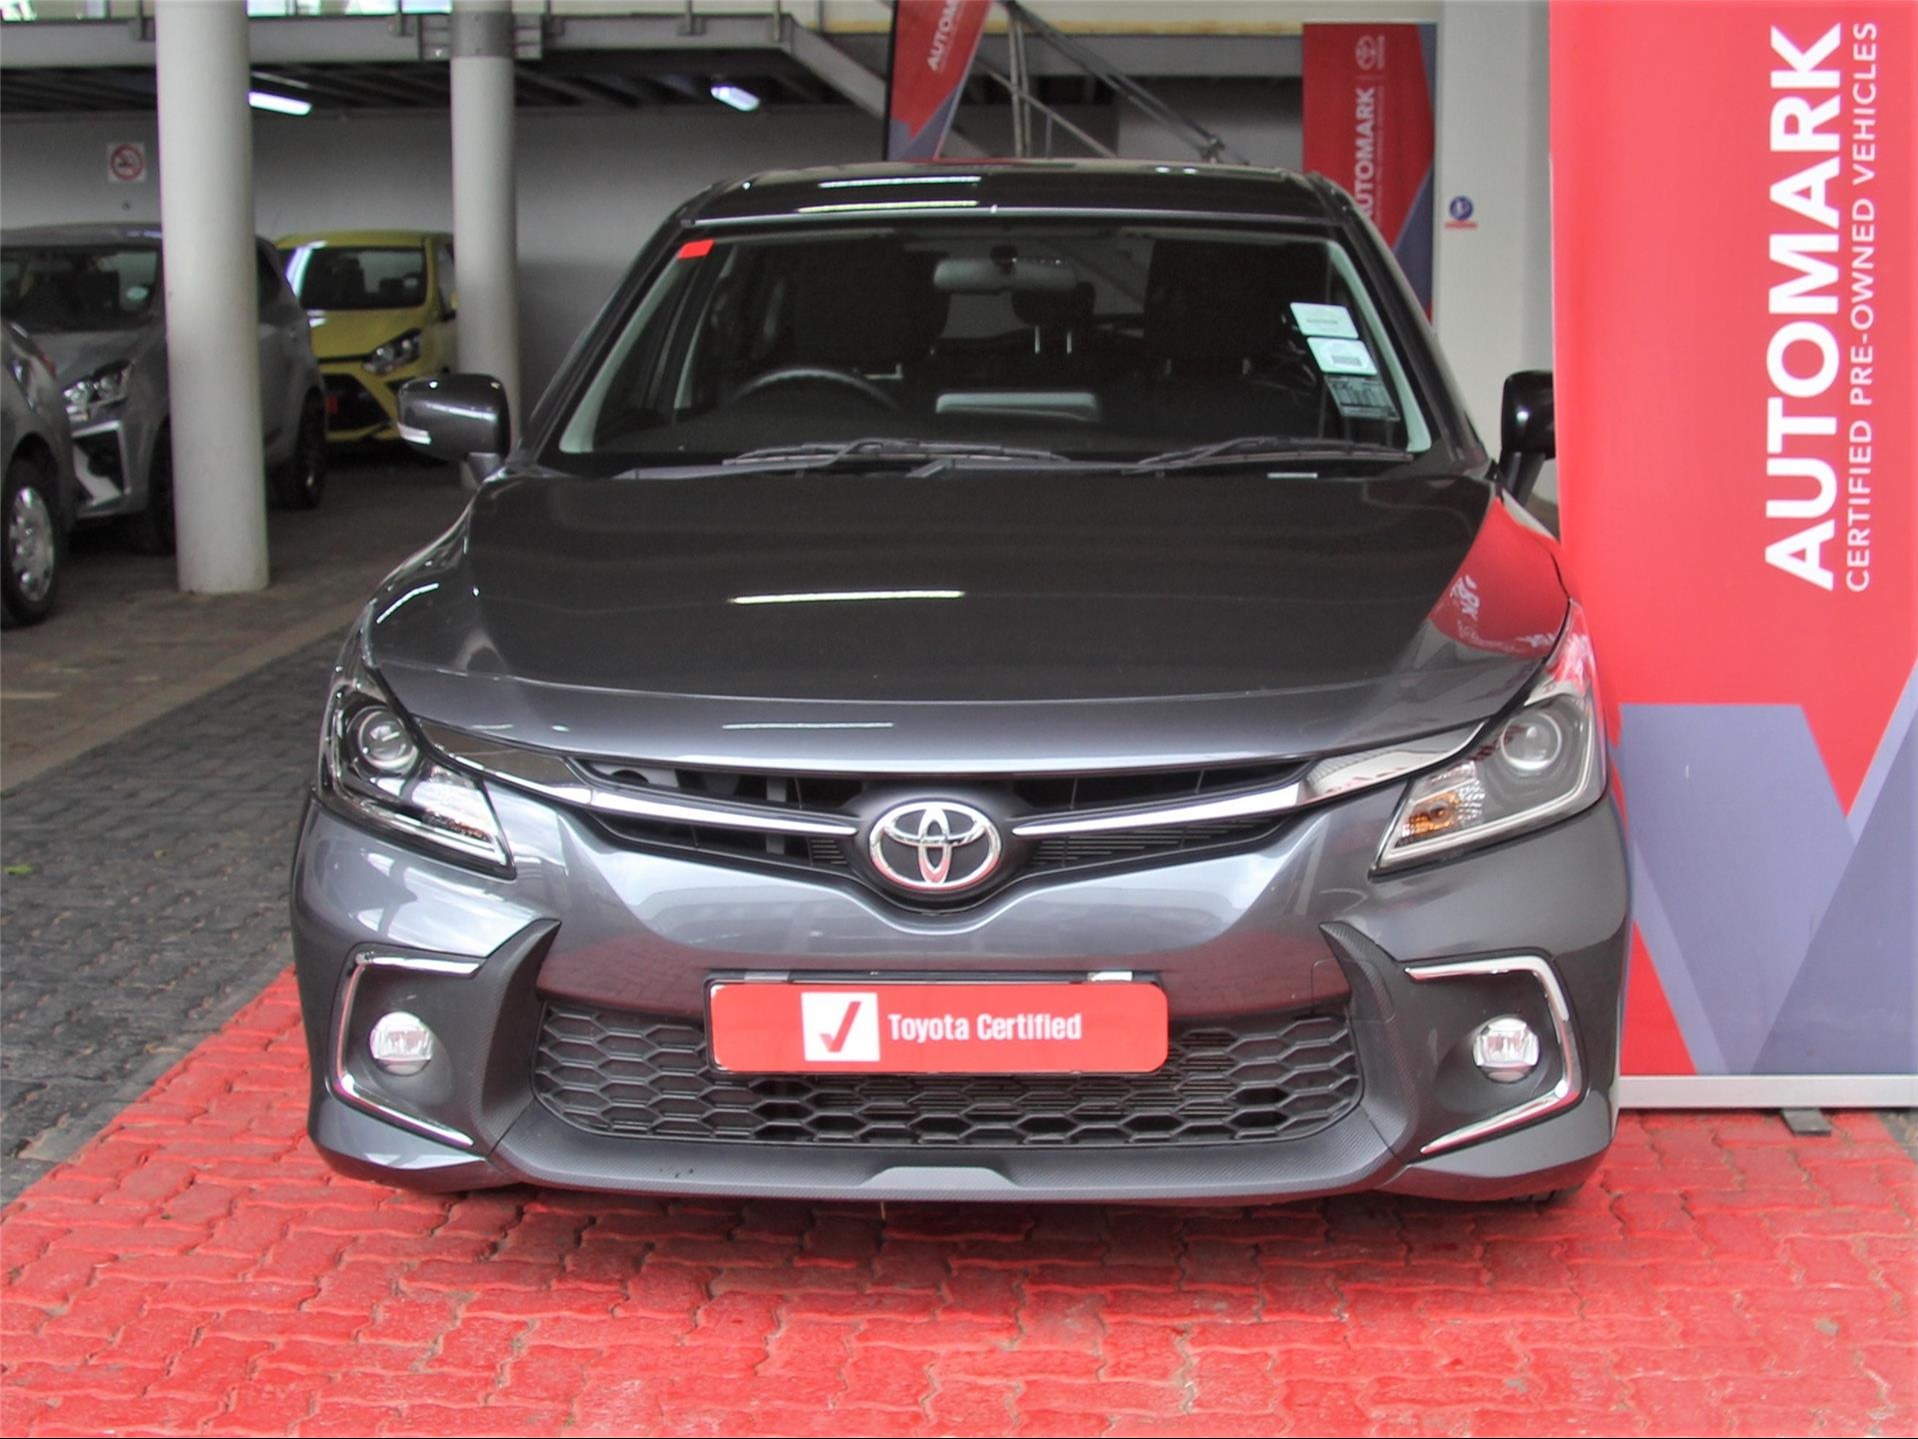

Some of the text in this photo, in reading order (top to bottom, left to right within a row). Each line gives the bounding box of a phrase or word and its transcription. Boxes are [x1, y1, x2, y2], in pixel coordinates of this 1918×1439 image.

[1765, 22, 1841, 592] AUTOMARK
[1845, 22, 1878, 592] CERTIFIED PRE-OWNED VEHICLES
[887, 1013, 1083, 1044] Toyota Certified
